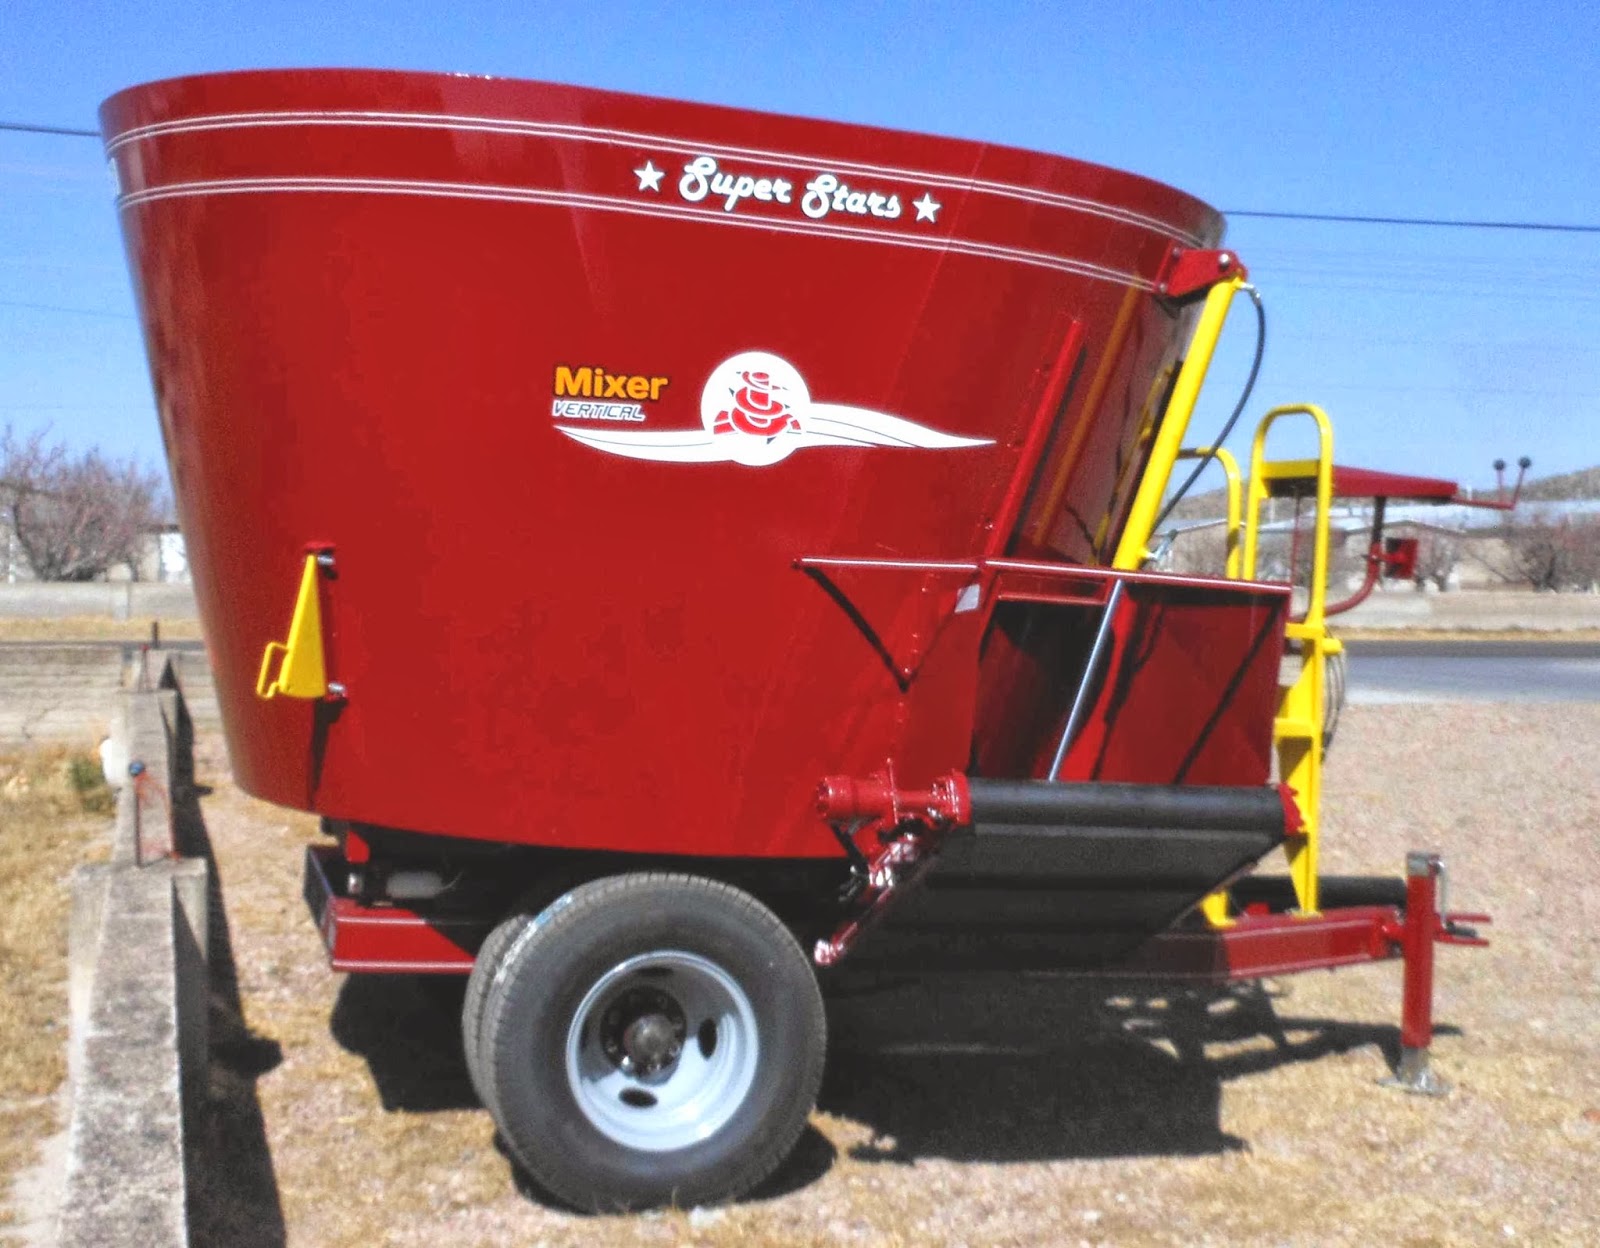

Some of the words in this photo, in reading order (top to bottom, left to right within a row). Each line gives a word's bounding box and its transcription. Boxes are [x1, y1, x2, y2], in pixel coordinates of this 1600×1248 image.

[678, 156, 792, 212] Super
[801, 174, 902, 219] Stars
[554, 366, 669, 400] Mixer
[552, 401, 646, 421] VERTICAL
